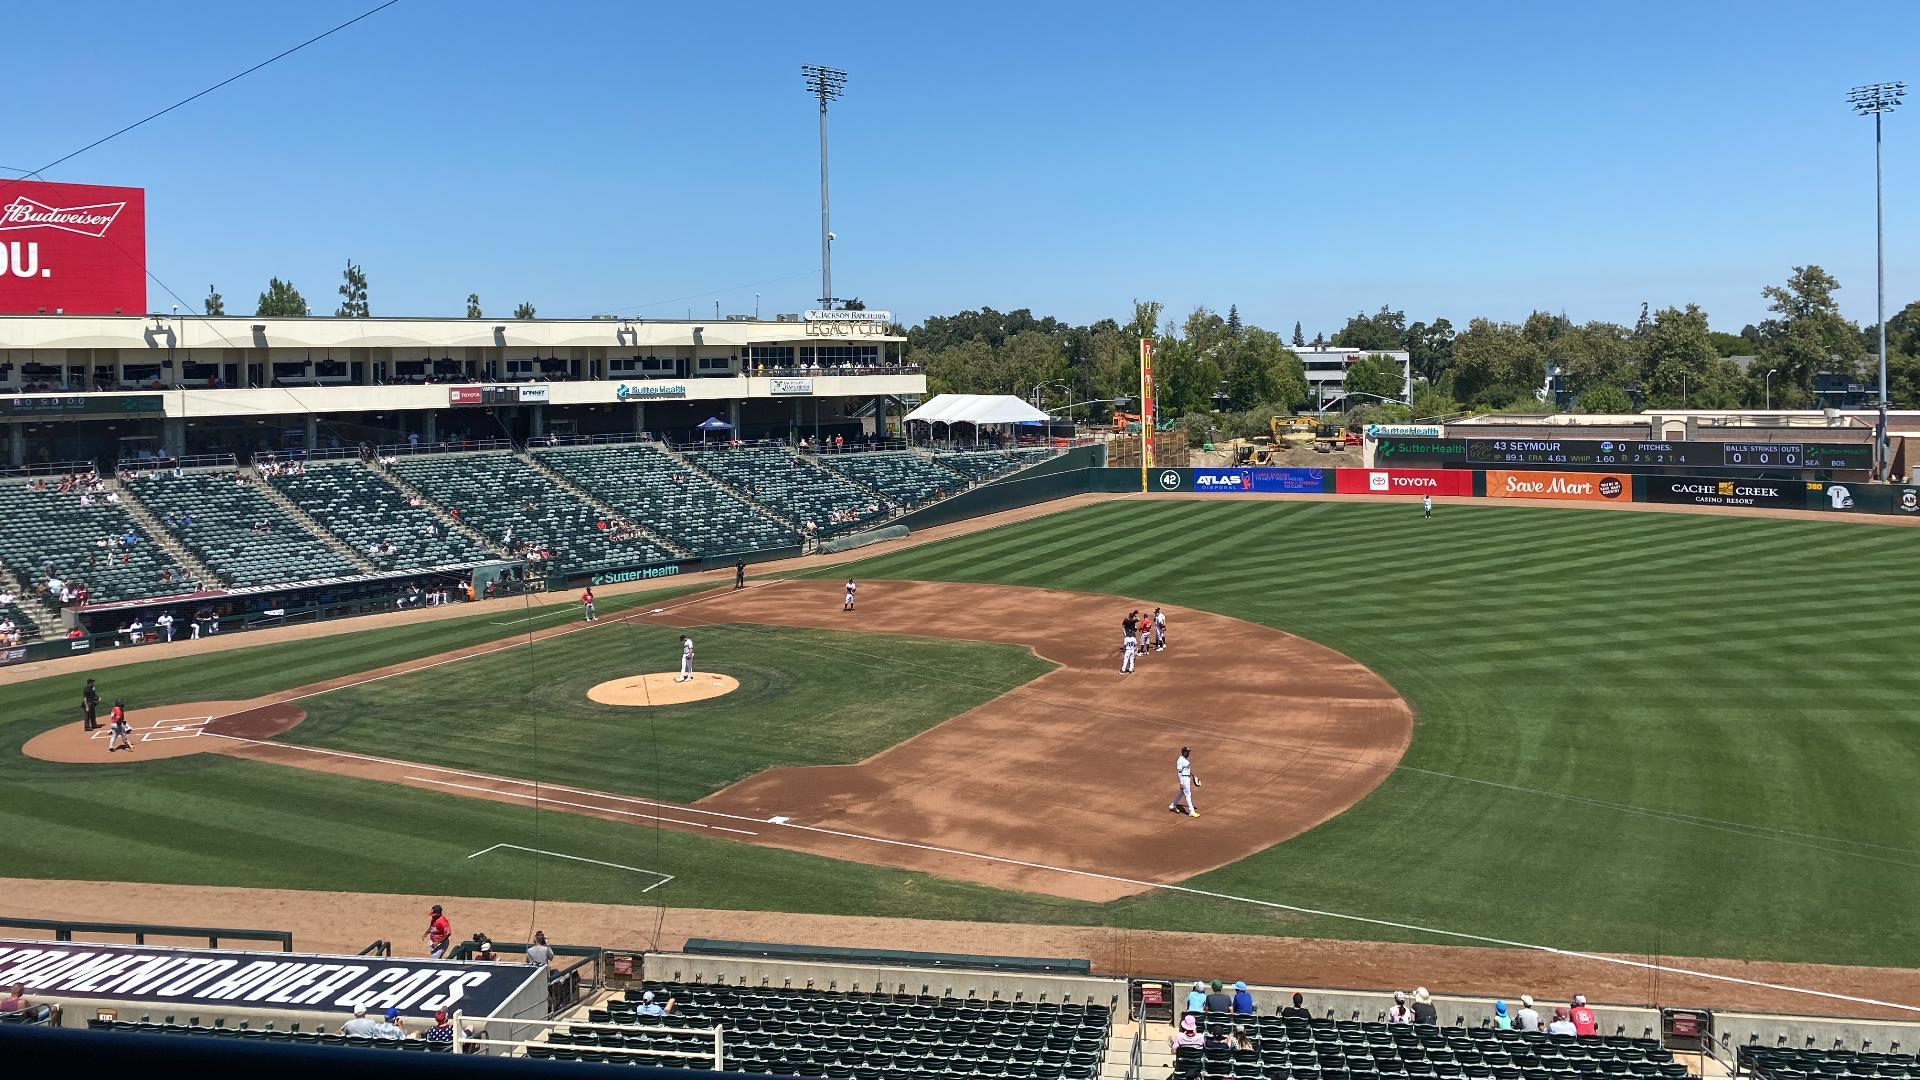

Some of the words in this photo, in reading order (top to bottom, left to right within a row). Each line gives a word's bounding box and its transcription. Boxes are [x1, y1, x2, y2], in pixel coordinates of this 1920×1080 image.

[4, 204, 113, 225] Budweiser
[805, 320, 856, 336] LEGACY
[631, 386, 658, 394] Sutter
[660, 384, 686, 394] Health
[1380, 426, 1409, 435] Sutter
[1410, 427, 1439, 435] Health
[1398, 443, 1431, 453] Sutter
[1432, 444, 1465, 454] Health
[1493, 442, 1507, 450] 43
[1510, 442, 1560, 451] SEYMOUR
[1619, 444, 1626, 452] 0
[1733, 453, 1741, 462] 0
[1760, 454, 1768, 463] 0
[1787, 454, 1795, 464] 0
[1163, 475, 1177, 485] 42
[1196, 475, 1242, 484] ATLAS
[1392, 477, 1437, 487] TOYOTA
[1506, 476, 1544, 493] Save
[1546, 477, 1593, 495] Mart
[1672, 484, 1715, 494] CACHE
[1735, 487, 1779, 497] CREEK
[604, 570, 641, 584] Sutter
[642, 565, 679, 578] Health
[208, 960, 372, 1004] RIVER
[334, 967, 492, 1012] CATS
